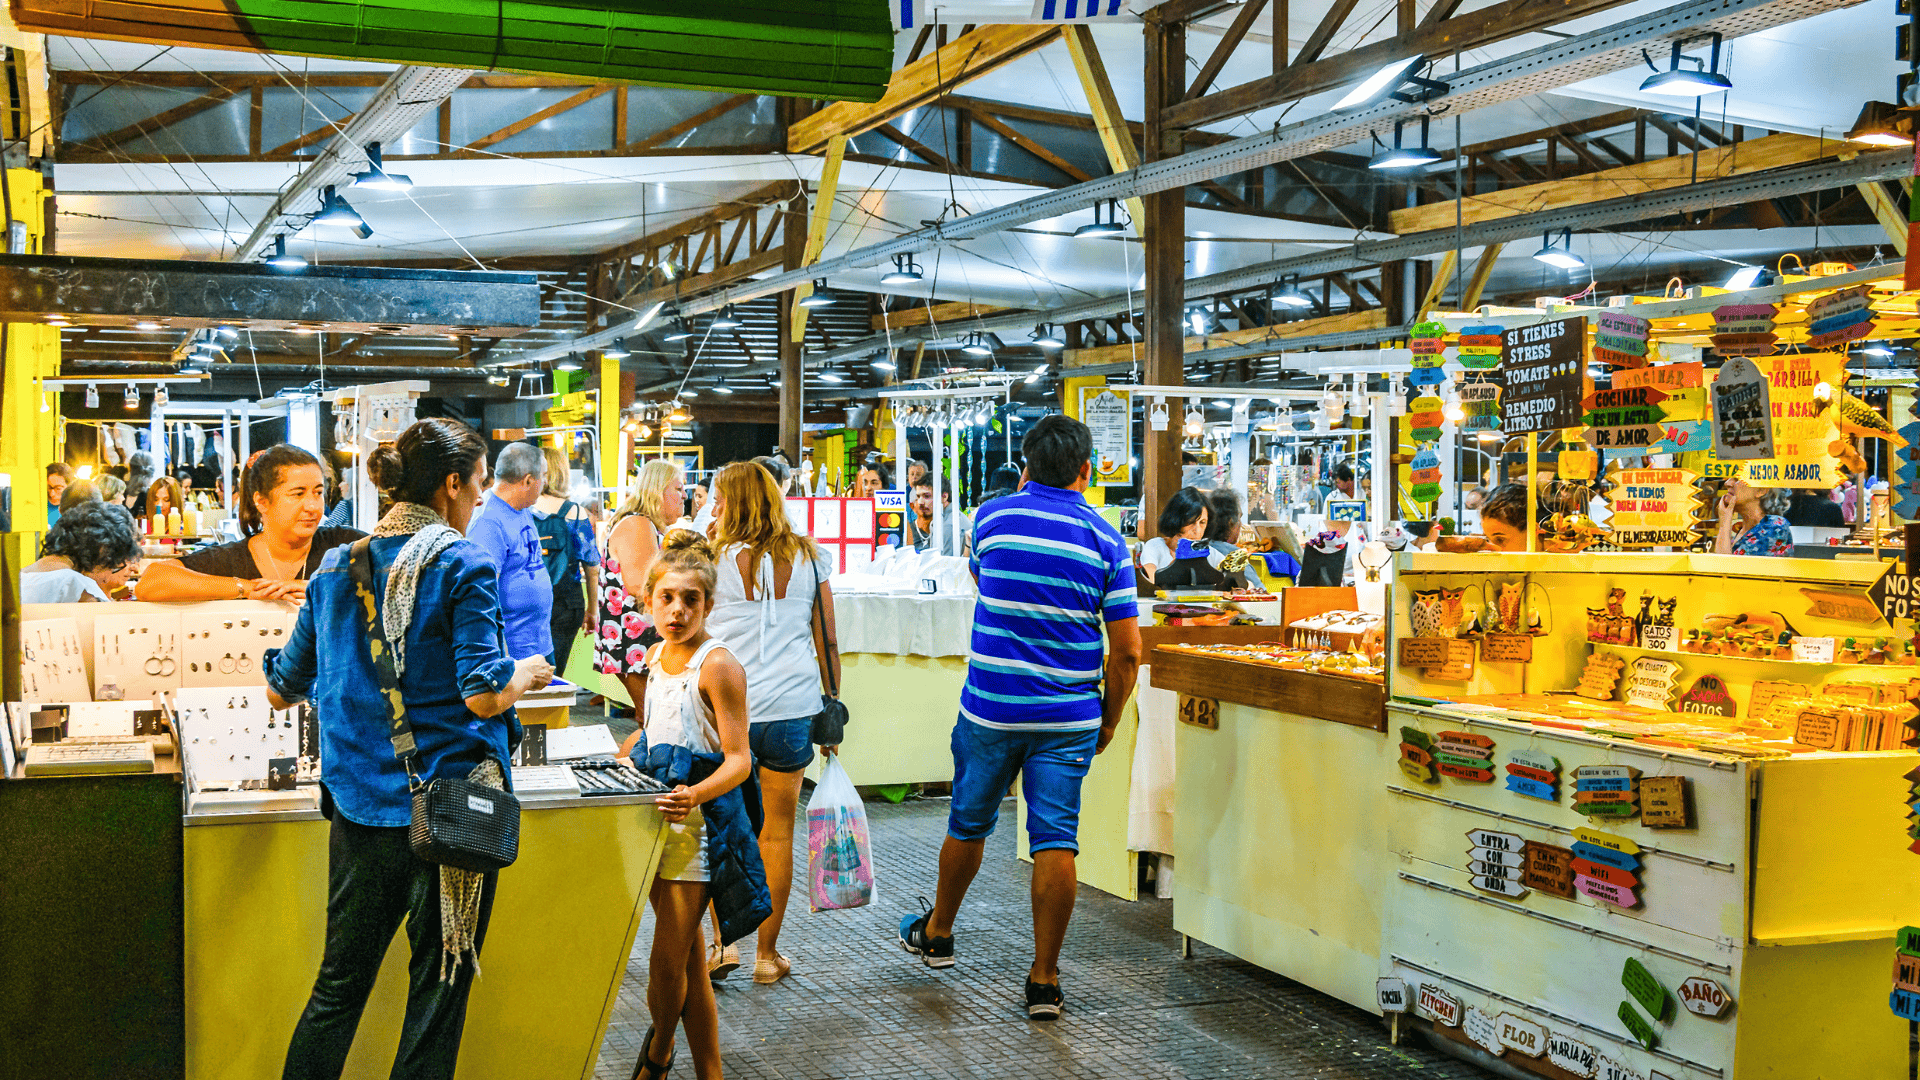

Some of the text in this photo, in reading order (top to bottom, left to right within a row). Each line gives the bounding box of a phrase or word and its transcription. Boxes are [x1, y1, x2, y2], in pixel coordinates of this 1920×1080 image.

[1507, 321, 1565, 346] SI TIENES
[1509, 343, 1551, 363] STRESS
[1505, 364, 1550, 385] TOMATE
[1767, 370, 1821, 389] PARRILLA
[1469, 387, 1496, 400] APLAUSO
[1595, 388, 1650, 408] COCINAR
[1505, 396, 1556, 417] REMEDIO
[1504, 414, 1535, 433] LITRO
[1535, 414, 1543, 429] Y
[1592, 409, 1650, 427] ES UN ACTO
[1595, 427, 1651, 446] DE AMOR
[1786, 444, 1799, 456] EL
[1621, 471, 1684, 485] EN ESTE LUGAR
[1749, 463, 1822, 482] MEJOR ASADOR
[880, 497, 902, 506] VISA
[1615, 500, 1668, 513] BUEN ASADO
[1884, 574, 1909, 595] NO
[1643, 625, 1672, 638] GATOS
[1647, 639, 1667, 650] 300
[1644, 662, 1668, 674] CUARTO
[1639, 676, 1667, 689] DESORDEN
[1700, 678, 1717, 691] NO
[1638, 689, 1666, 701] PROBLEMA
[1690, 688, 1726, 703] SACAR
[1184, 698, 1210, 725] 42
[1683, 702, 1724, 716] FOTOS
[1480, 833, 1510, 851] ENTRA
[1580, 833, 1620, 850] EN ESTE LUGAR
[1486, 849, 1503, 864] CON
[1481, 861, 1508, 879] BUENA
[1533, 860, 1561, 876] CUARTO
[1484, 876, 1506, 893] ONDA
[1529, 872, 1556, 888] MANDO
[1381, 989, 1403, 1005] COCINA
[1679, 982, 1723, 1007] BAÑO
[1420, 990, 1455, 1021] KITCHEN
[1502, 1023, 1536, 1050] FLOR
